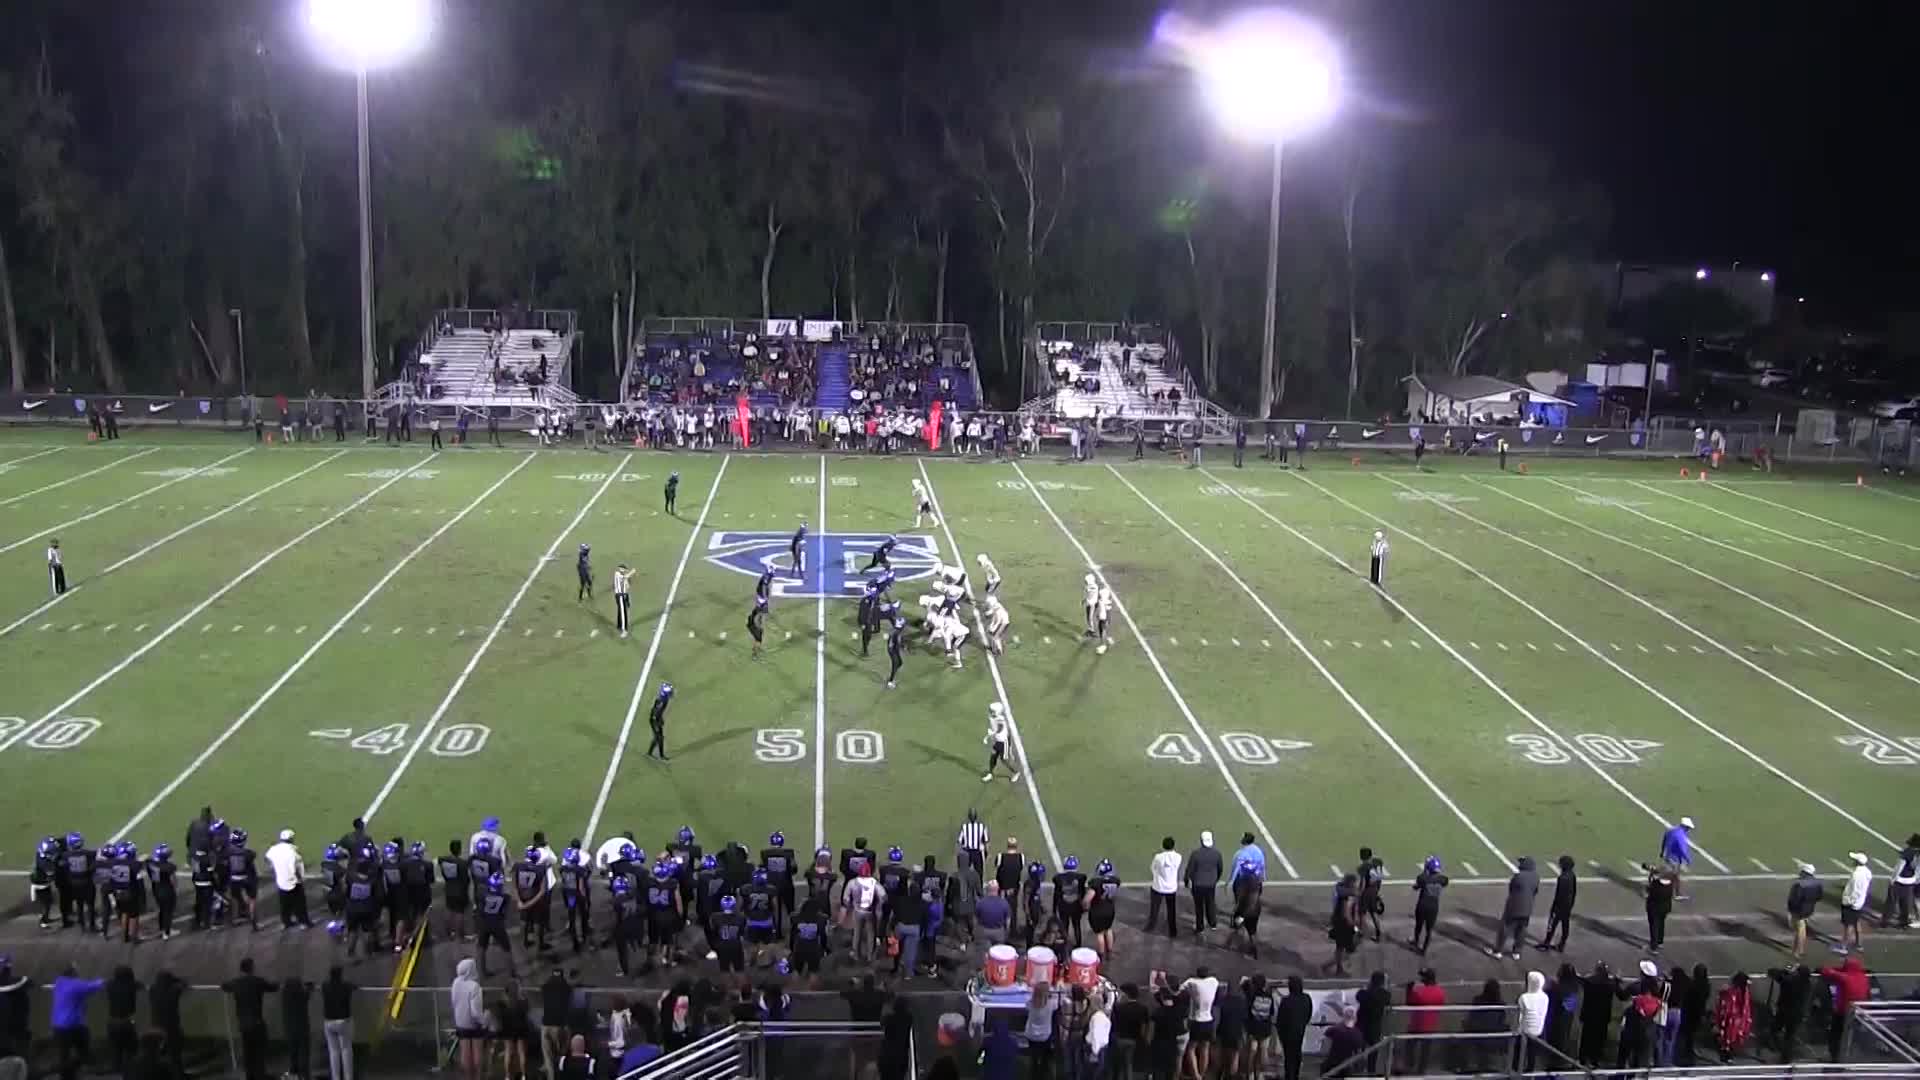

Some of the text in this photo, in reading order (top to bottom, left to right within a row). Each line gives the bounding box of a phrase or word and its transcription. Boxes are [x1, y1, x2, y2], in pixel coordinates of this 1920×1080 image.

[351, 723, 491, 756] 40
[755, 728, 884, 762] 50
[1147, 732, 1280, 764] 40
[1506, 733, 1641, 763] 30
